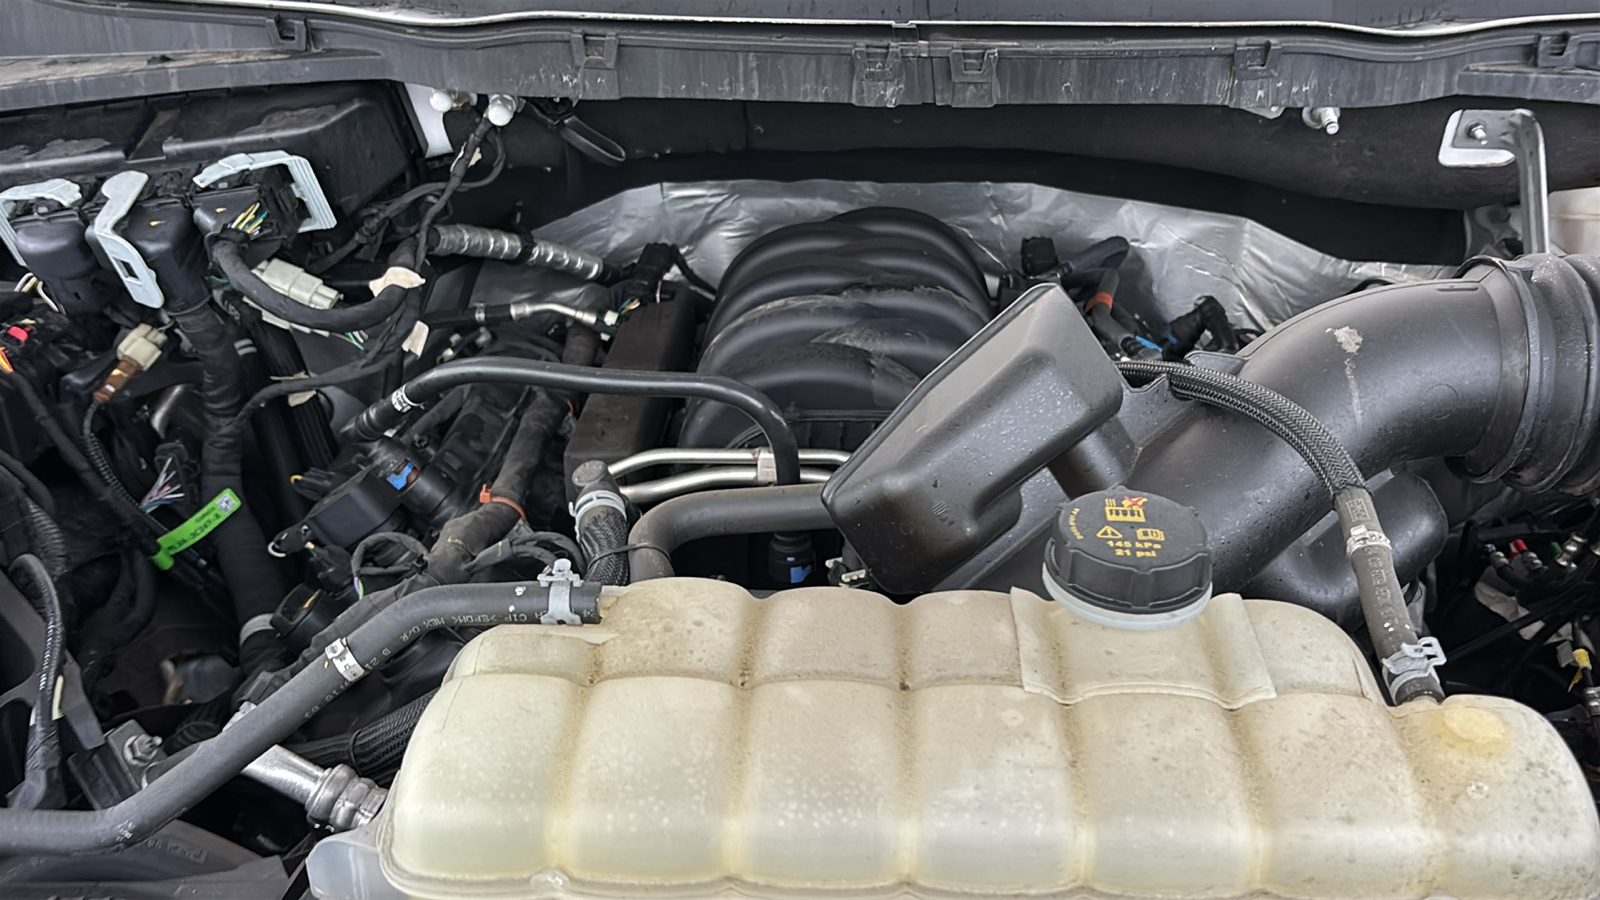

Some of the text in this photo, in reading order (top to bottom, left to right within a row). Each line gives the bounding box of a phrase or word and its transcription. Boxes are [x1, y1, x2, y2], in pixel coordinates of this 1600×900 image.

[1106, 540, 1162, 550] 145 kPa
[1114, 548, 1157, 558] 21 psi
[504, 612, 527, 622] CIP
